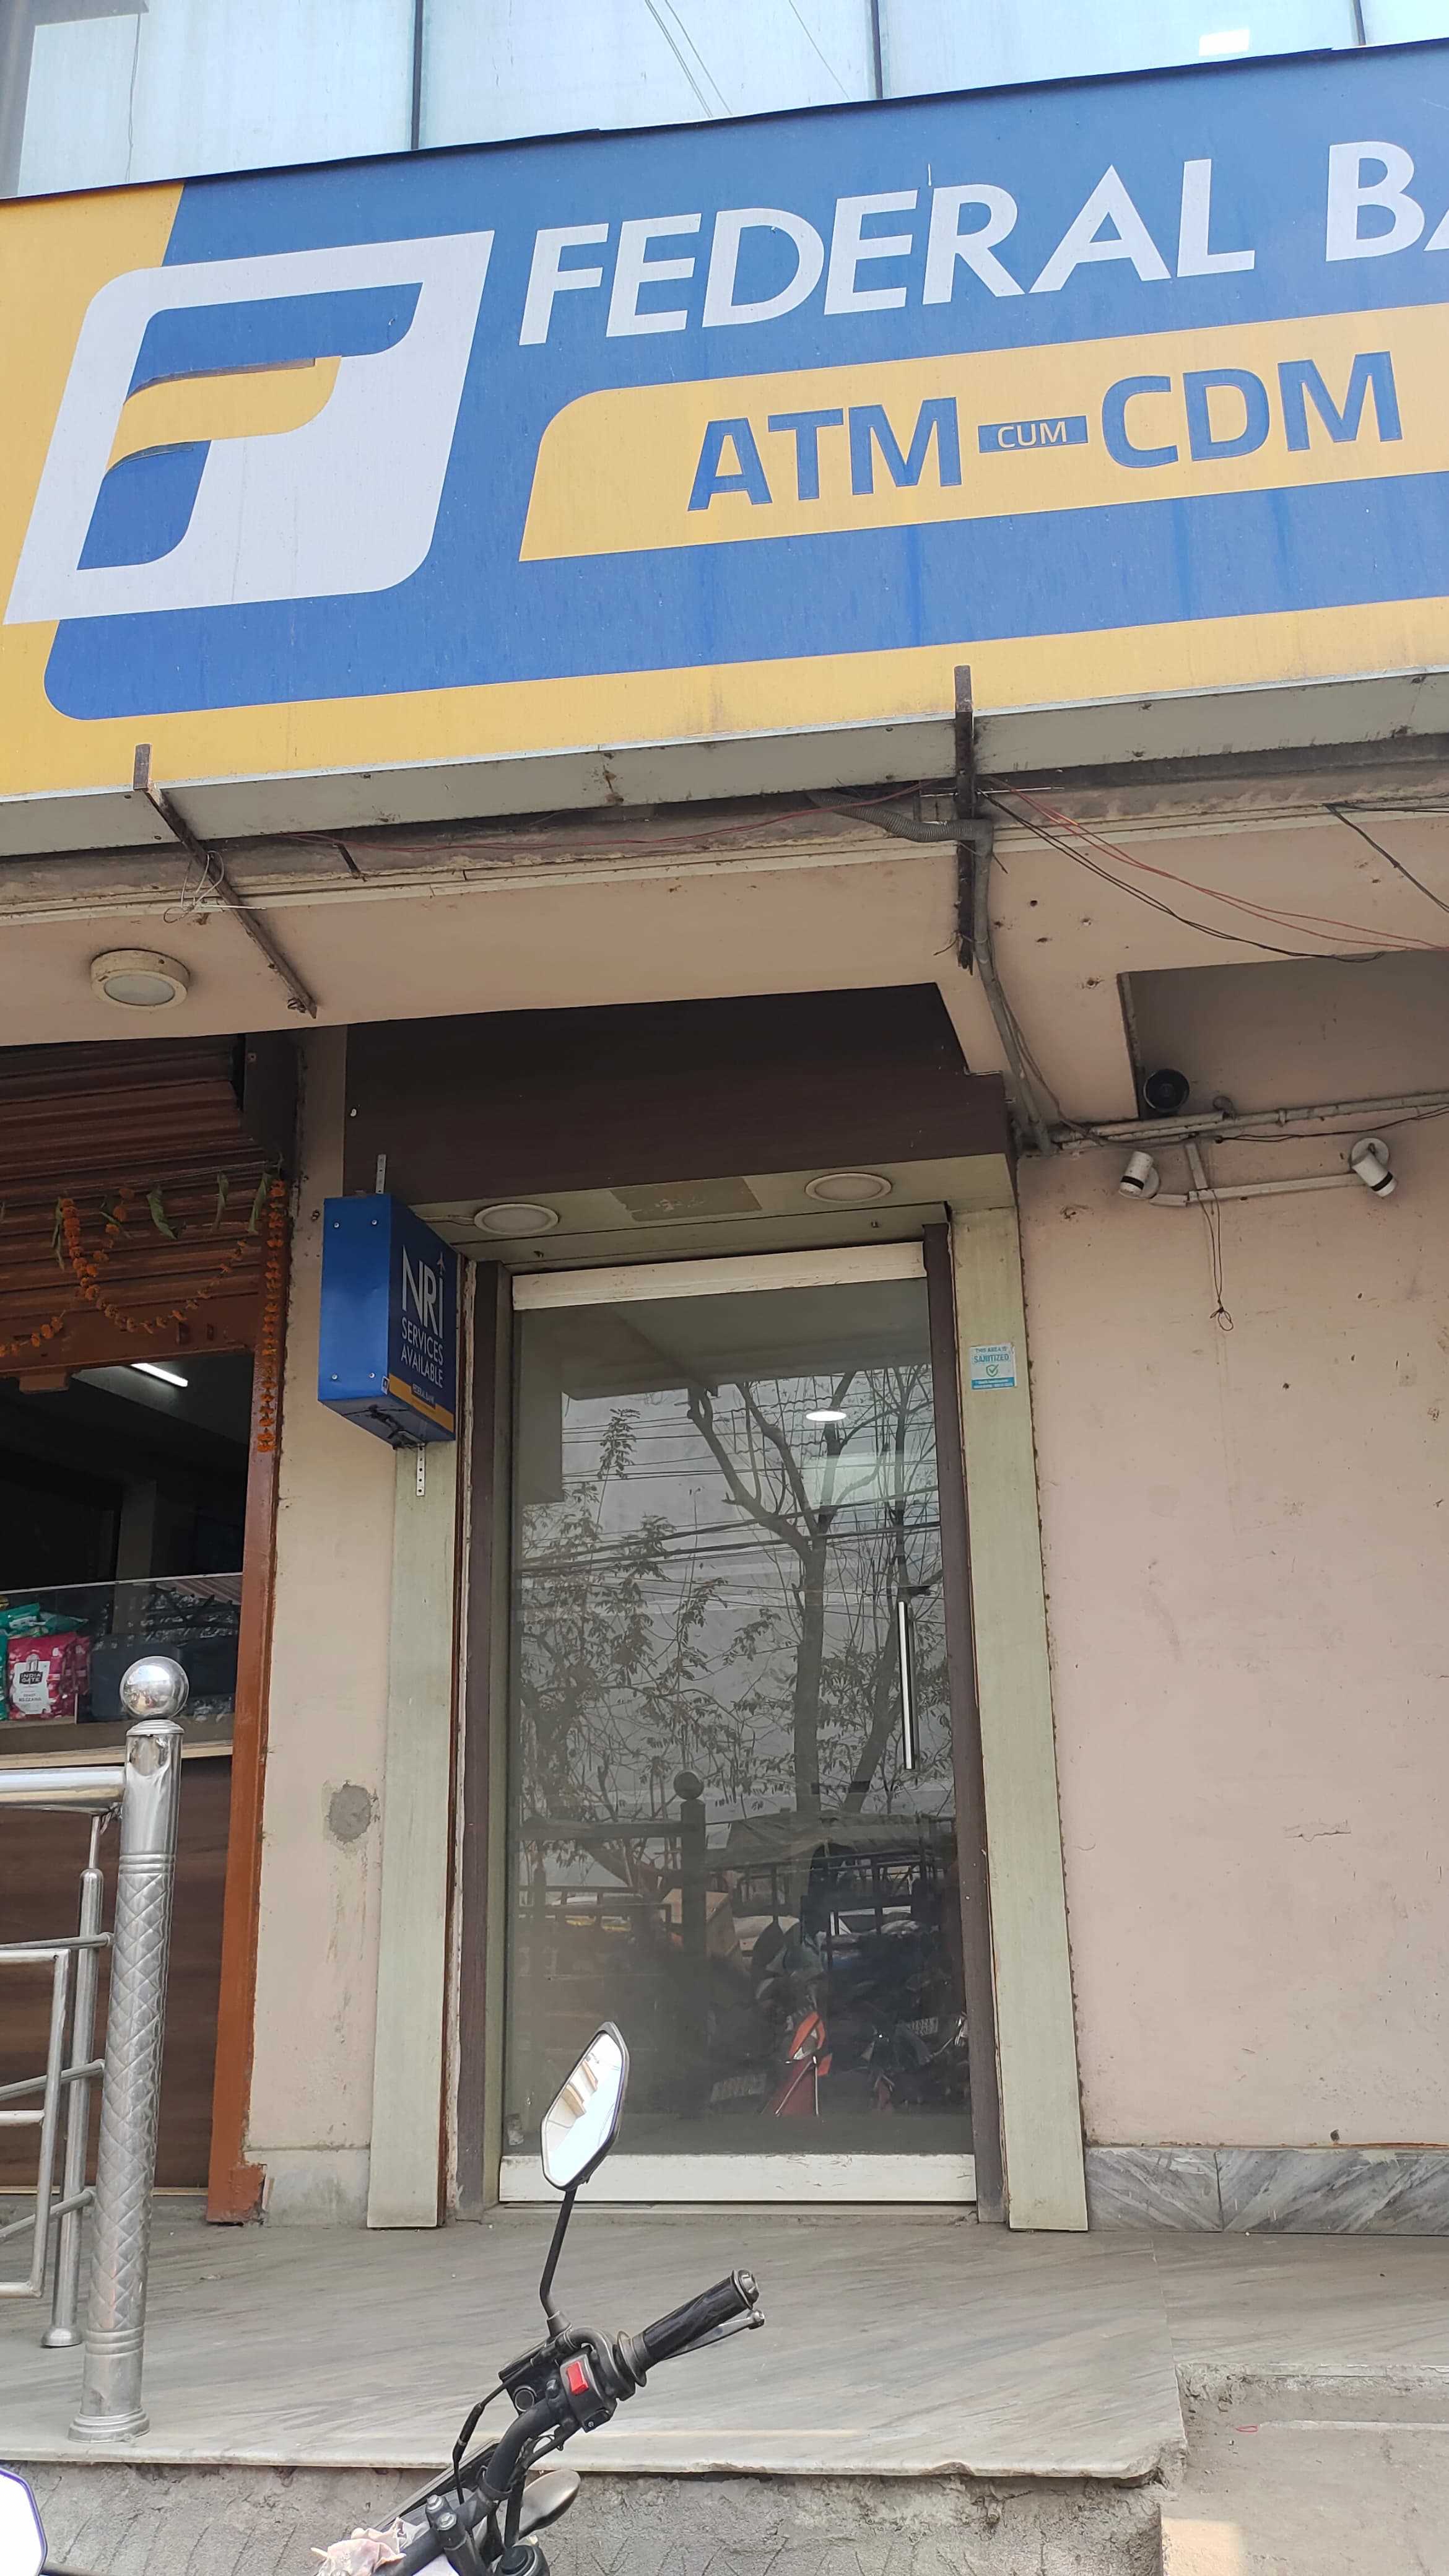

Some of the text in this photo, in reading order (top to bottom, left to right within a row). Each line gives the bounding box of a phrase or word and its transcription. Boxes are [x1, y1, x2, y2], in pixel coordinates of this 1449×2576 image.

[518, 141, 1449, 346] FEDERAL B
[687, 350, 1403, 512] ATM CUM CDM
[402, 1243, 443, 1339] NRI
[401, 1316, 443, 1367] SERVICES
[401, 1344, 443, 1389] AVAILABLE
[973, 1354, 1009, 1363] SANITIZED
